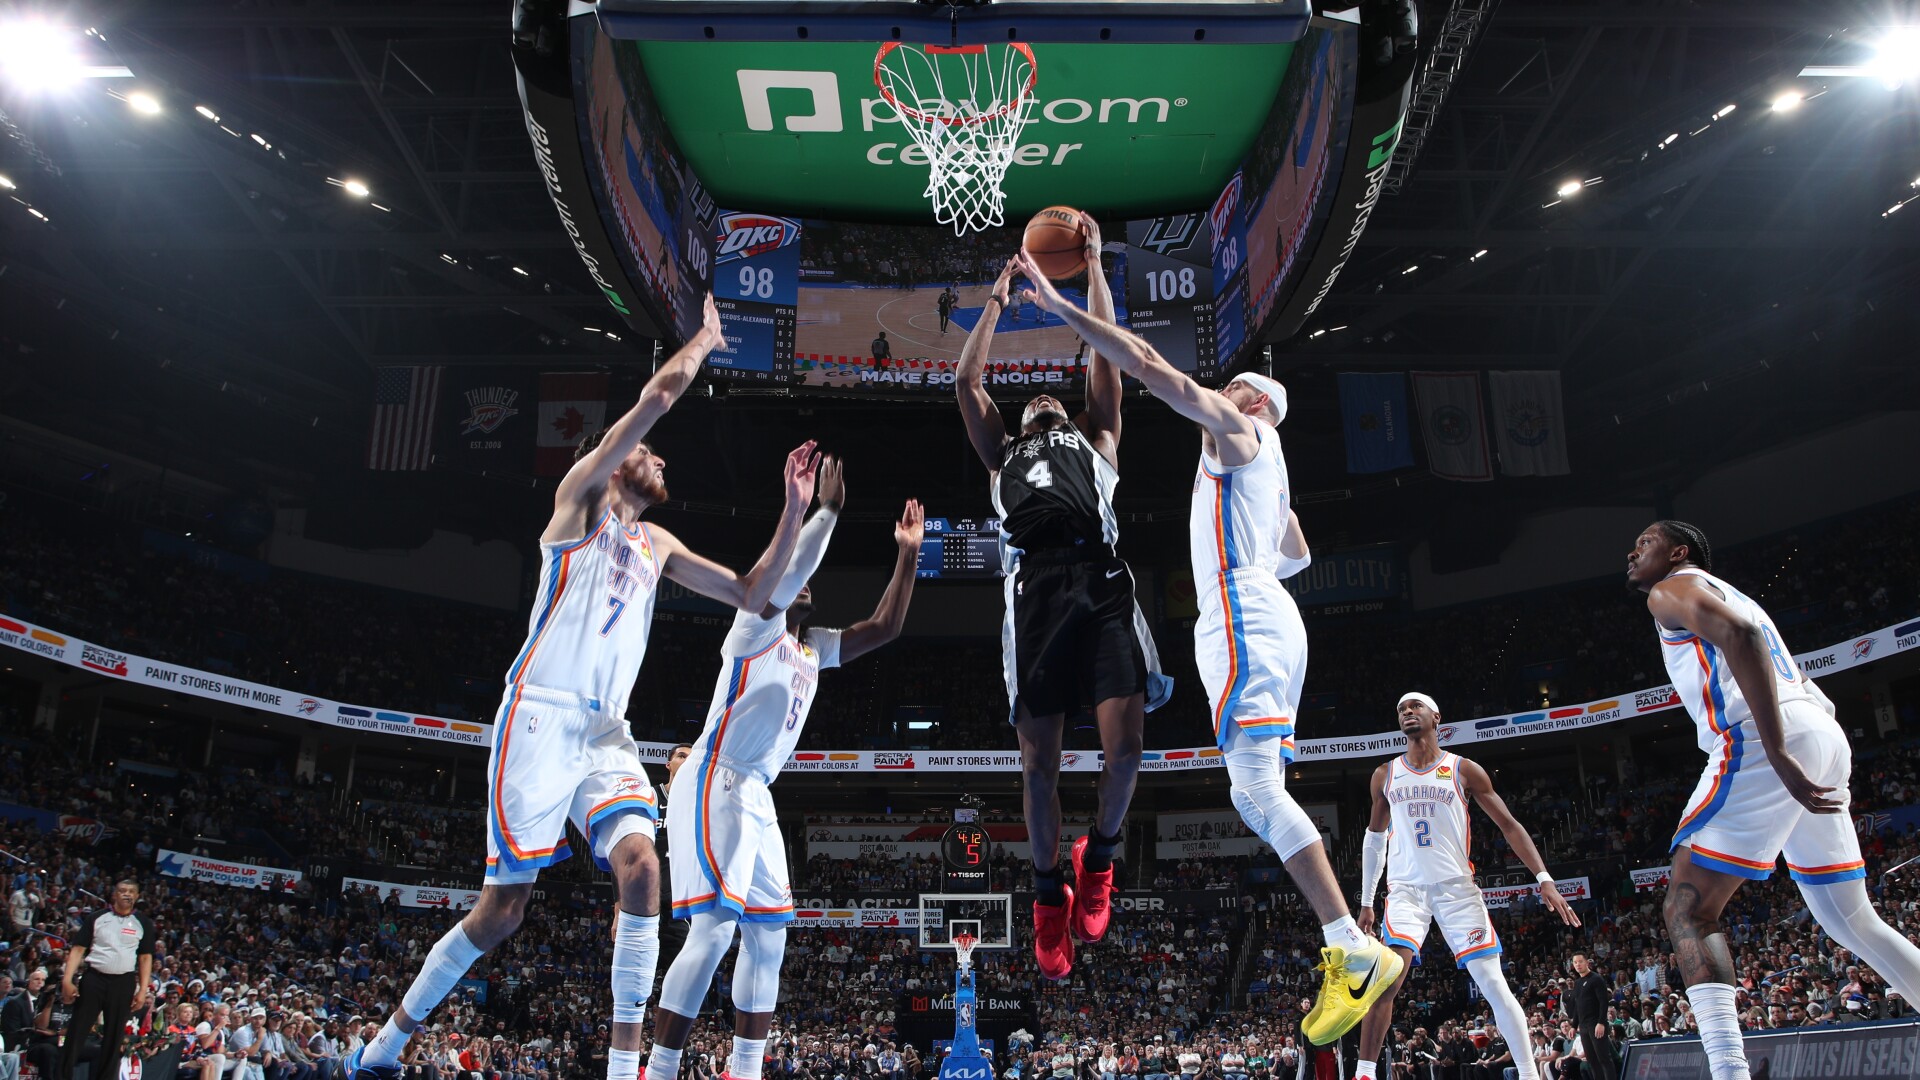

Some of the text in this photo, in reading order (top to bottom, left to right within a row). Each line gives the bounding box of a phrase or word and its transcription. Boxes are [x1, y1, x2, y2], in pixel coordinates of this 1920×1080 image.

[866, 138, 1083, 166] ceer
[719, 225, 782, 254] OKC
[1304, 161, 1388, 315] paycom center
[687, 228, 708, 281] 108
[1222, 236, 1237, 280] 98
[739, 265, 774, 299] 98
[1145, 267, 1196, 302] 108
[715, 301, 736, 310] PLAYER
[719, 312, 774, 325] LGEOUS-ALEXANDER
[1132, 310, 1153, 318] PLAYER
[1132, 319, 1171, 329] WEMBANYAMA
[710, 356, 733, 365] CARUSO
[756, 372, 767, 380] 4TH
[861, 371, 921, 383] MAKE
[927, 372, 986, 384] SOE
[992, 370, 1063, 385] NOISE!
[464, 386, 519, 406] THUNDER
[474, 409, 502, 426] OKC
[1383, 400, 1394, 442] OKLAHOMA
[470, 440, 502, 449] EST. 2008
[1026, 459, 1052, 488] 4
[924, 520, 942, 530] 98
[1345, 558, 1391, 591] CITY
[606, 565, 639, 601] CITY
[599, 593, 627, 638] 7
[1324, 601, 1384, 615] EXIT NOW
[693, 616, 717, 625] EXIT
[20, 638, 53, 655] COLORS
[53, 649, 65, 659] AT
[1896, 635, 1917, 649] FIND
[81, 650, 118, 669] PAINT
[83, 644, 127, 662] SPECTRUM
[1759, 620, 1797, 684] 8
[1804, 654, 1836, 672] MORE
[145, 666, 282, 706] PAINT STORES WITH MORE
[1635, 694, 1670, 708] PAINT
[785, 693, 803, 733] 5
[337, 716, 482, 743] FIND YOUR THUNDER PAINT COLORS AT
[1476, 709, 1621, 739] FIND YOUR THUNDER PAINT COLORS AT
[646, 748, 669, 758] MOR
[1300, 736, 1407, 755] PAINT STORES WITH MO
[822, 762, 849, 770] COLORS
[928, 757, 955, 766] PAINT
[956, 756, 991, 766] STORES
[992, 756, 1016, 766] WITH
[1192, 758, 1219, 767] COLORS
[1389, 785, 1455, 806] OKLAHOMA
[1407, 802, 1435, 817] CITY
[1175, 824, 1199, 836] POST
[1214, 822, 1234, 834] OAK
[1414, 819, 1433, 848] 2
[958, 833, 981, 844] 4:12
[1182, 842, 1221, 851] POST OAK
[860, 844, 898, 852] POST OAK
[967, 844, 979, 864] 5
[192, 859, 257, 876] THUNDER UP
[263, 870, 295, 879] SPERUM
[309, 865, 329, 878] 109
[1633, 871, 1666, 879] SPECTRUM
[190, 869, 256, 885] YOUR COLORS
[1485, 889, 1526, 898] THUNDE
[1110, 897, 1165, 911] NDER
[1219, 897, 1236, 908] 111
[931, 998, 1021, 1010] MIDST BANK
[1769, 1036, 1920, 1078] ALWAYS IN SEAS
